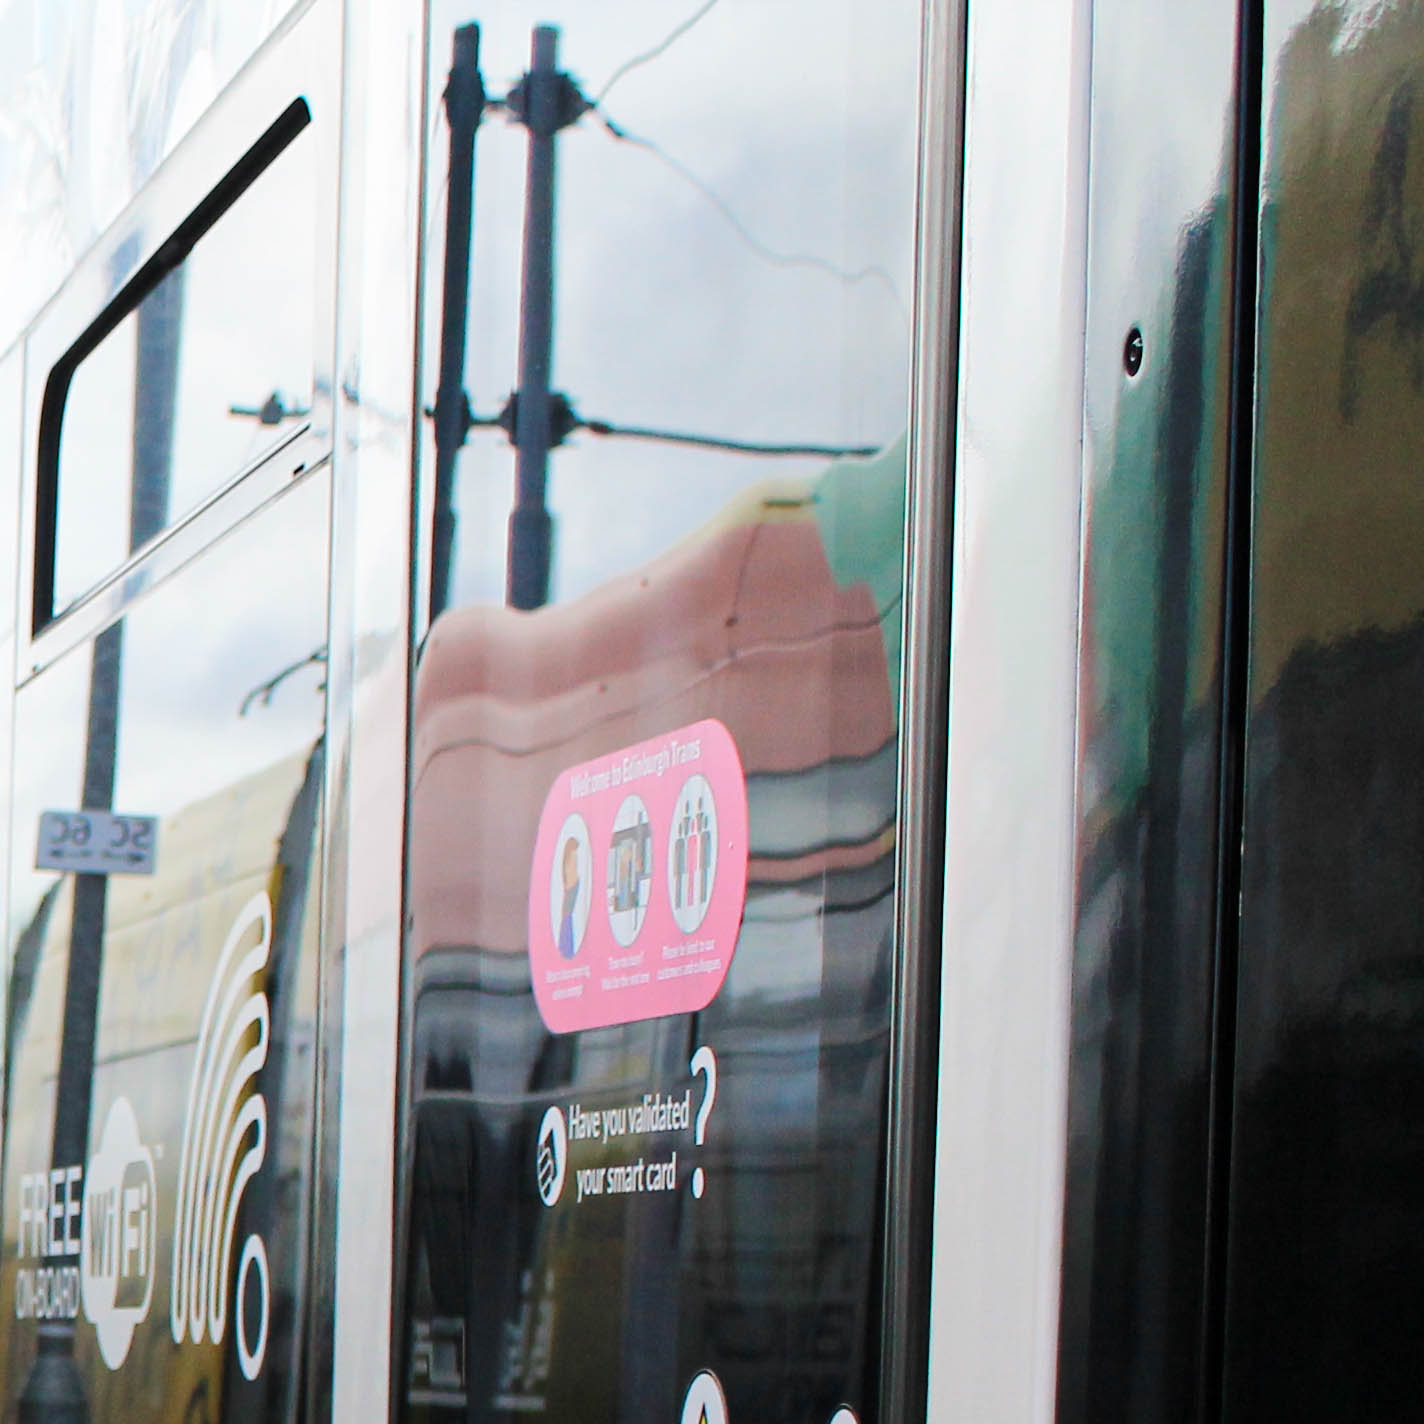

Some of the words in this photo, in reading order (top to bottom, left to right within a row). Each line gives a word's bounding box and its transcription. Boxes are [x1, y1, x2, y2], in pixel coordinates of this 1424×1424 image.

[568, 1103, 601, 1140] Have
[602, 1107, 627, 1144] you
[628, 1089, 691, 1135] validated
[576, 1168, 606, 1203] your
[607, 1157, 644, 1194] smart
[646, 1151, 677, 1192] card
[17, 1164, 83, 1258] FREE
[16, 1266, 81, 1320] ON-BOARD
